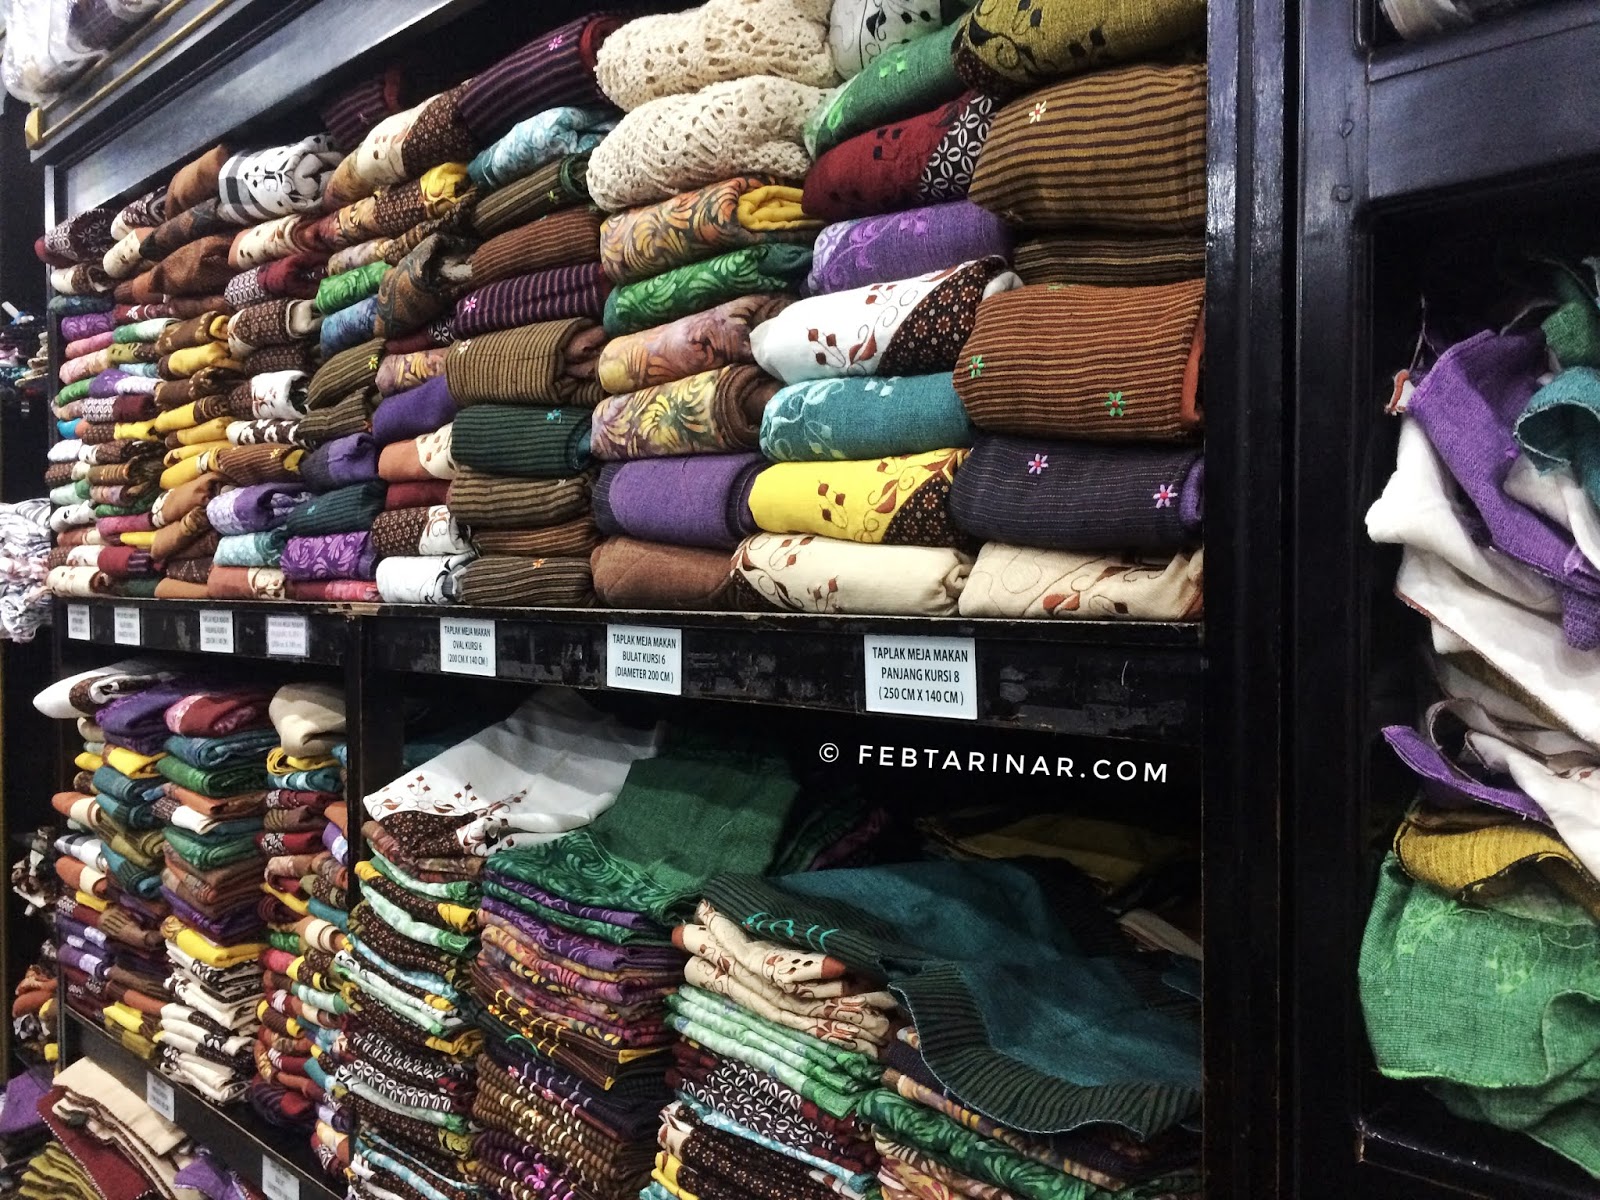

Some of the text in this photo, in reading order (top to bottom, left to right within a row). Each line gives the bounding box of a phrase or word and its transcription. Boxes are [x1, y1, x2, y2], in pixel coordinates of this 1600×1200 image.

[613, 633, 676, 649] TAPLAK MEJA MAKAN
[622, 651, 666, 665] BULAT KURSI 6
[872, 646, 968, 663] TAPLAK MEJA MAKAN
[615, 666, 647, 679] (DIAMETER
[647, 670, 659, 681] 200
[881, 666, 960, 683] PANJANG KURSI 8
[883, 687, 900, 700] 250
[901, 688, 916, 701] CM
[916, 688, 923, 702] X
[925, 689, 942, 703] 140
[943, 691, 959, 704] CM
